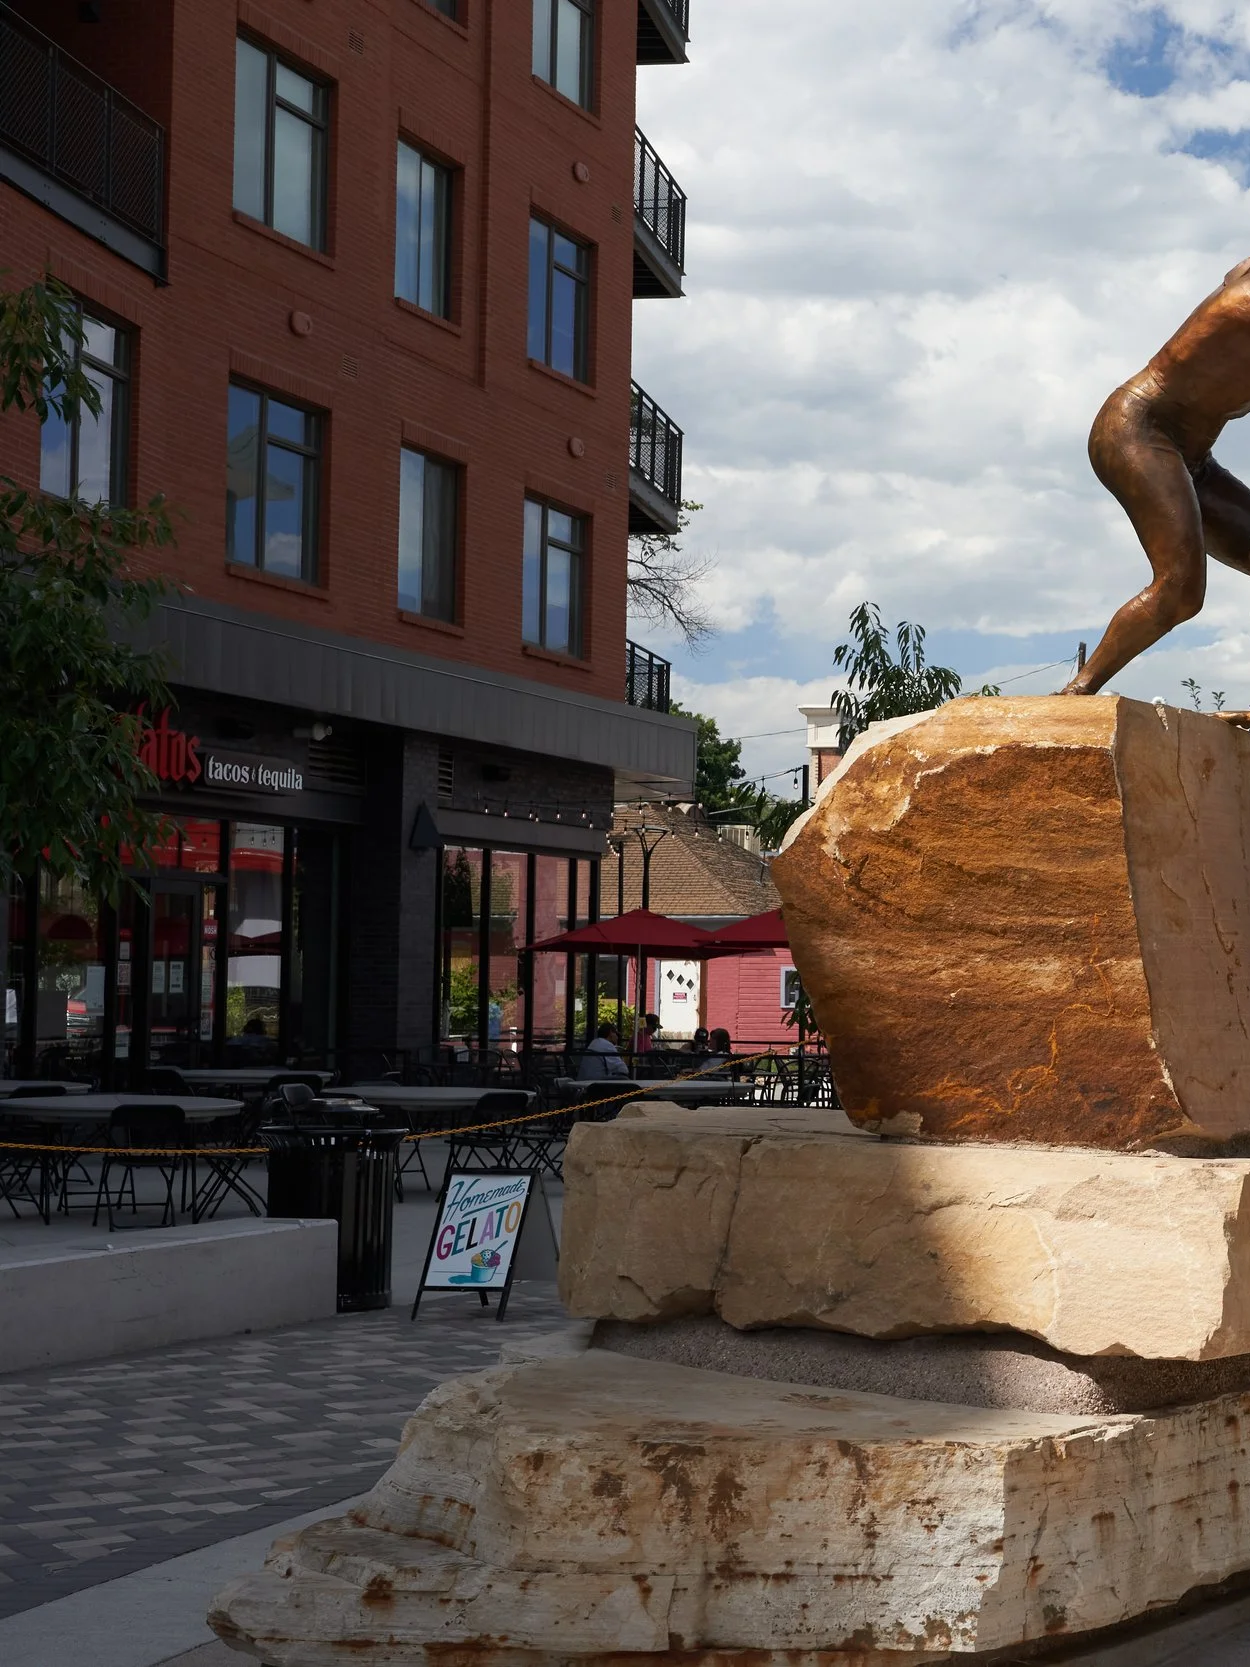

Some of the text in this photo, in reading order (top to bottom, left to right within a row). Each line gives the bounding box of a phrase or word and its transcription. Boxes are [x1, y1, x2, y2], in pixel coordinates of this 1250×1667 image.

[131, 698, 202, 784] atos
[208, 756, 250, 783] tacos
[257, 764, 303, 791] tequila
[443, 1178, 526, 1224] Homemade
[436, 1201, 522, 1260] GELATO
